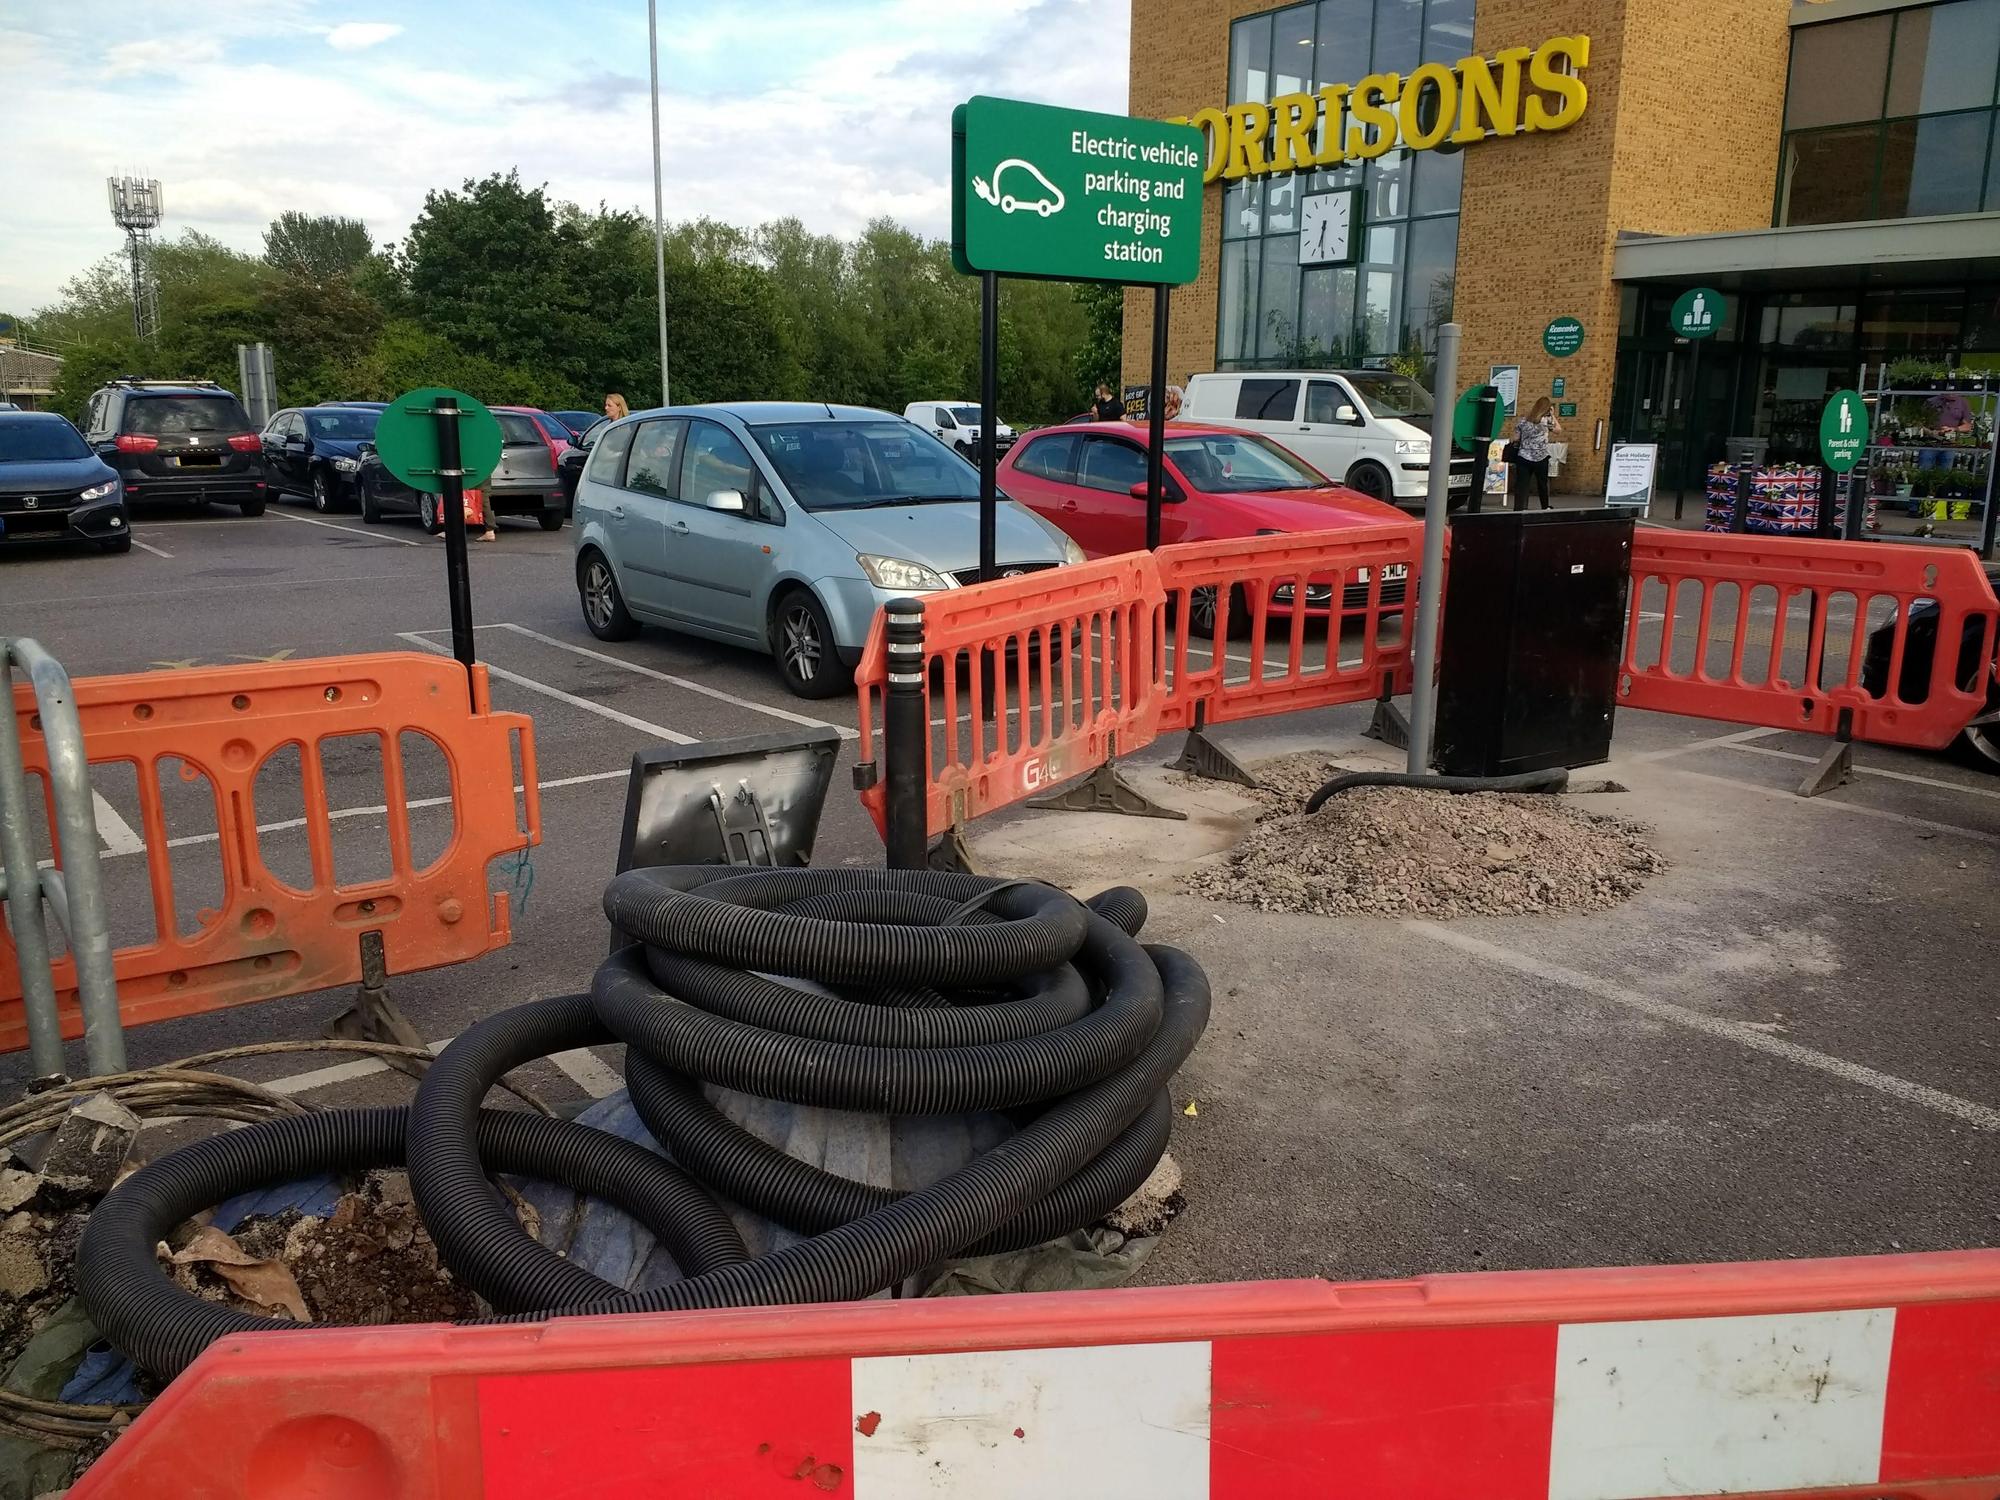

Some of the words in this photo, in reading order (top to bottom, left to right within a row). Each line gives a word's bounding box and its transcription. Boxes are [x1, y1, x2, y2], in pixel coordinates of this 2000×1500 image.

[1167, 35, 1590, 184] ORRISONS
[1071, 131, 1137, 160] Electric
[1140, 141, 1199, 168] vehicle
[1085, 169, 1150, 202] parking
[1153, 178, 1184, 199] and
[1097, 204, 1171, 238] charging
[1104, 240, 1163, 264] station
[1549, 324, 1579, 333] Remember
[1126, 398, 1146, 414] FREE
[1828, 438, 1843, 448] Parent
[1848, 438, 1859, 448] child
[1833, 449, 1852, 460] parking
